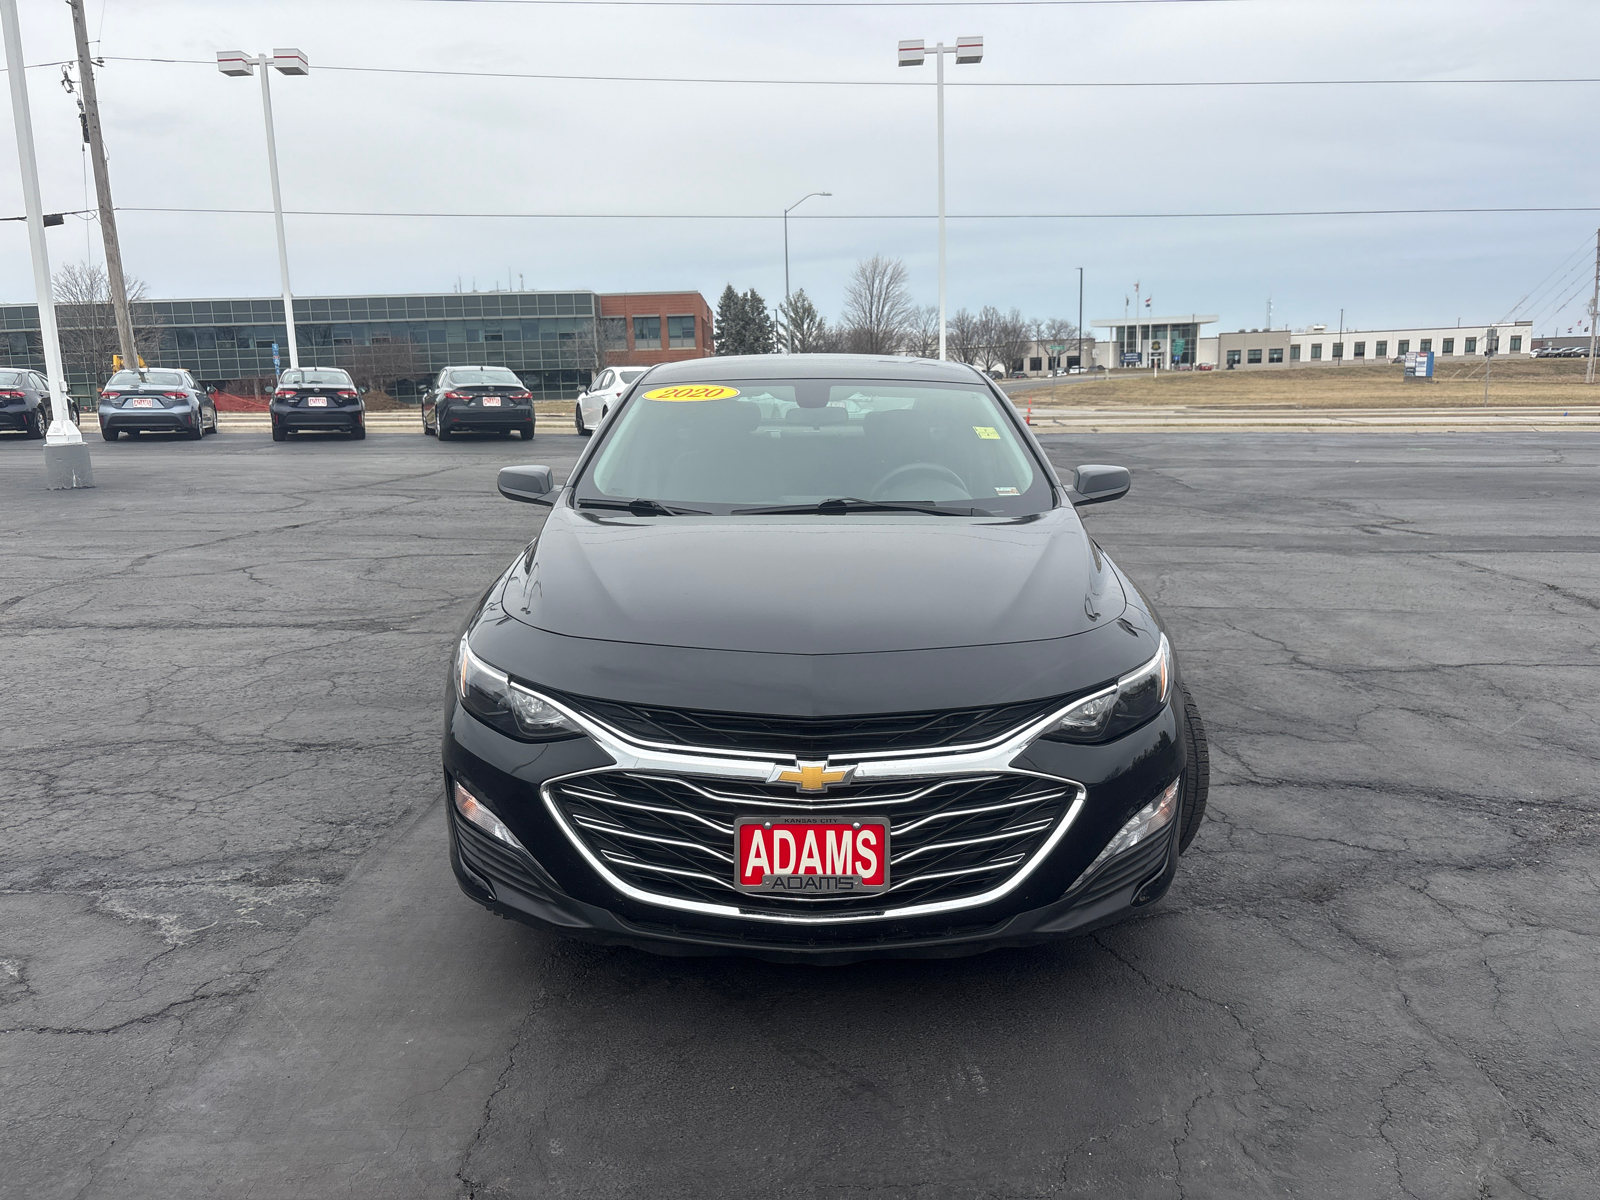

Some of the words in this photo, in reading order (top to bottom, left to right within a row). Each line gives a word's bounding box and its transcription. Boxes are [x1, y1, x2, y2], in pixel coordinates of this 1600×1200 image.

[656, 388, 725, 399] 2020
[745, 829, 878, 879] ADAMS
[771, 876, 854, 890] ADAMS
